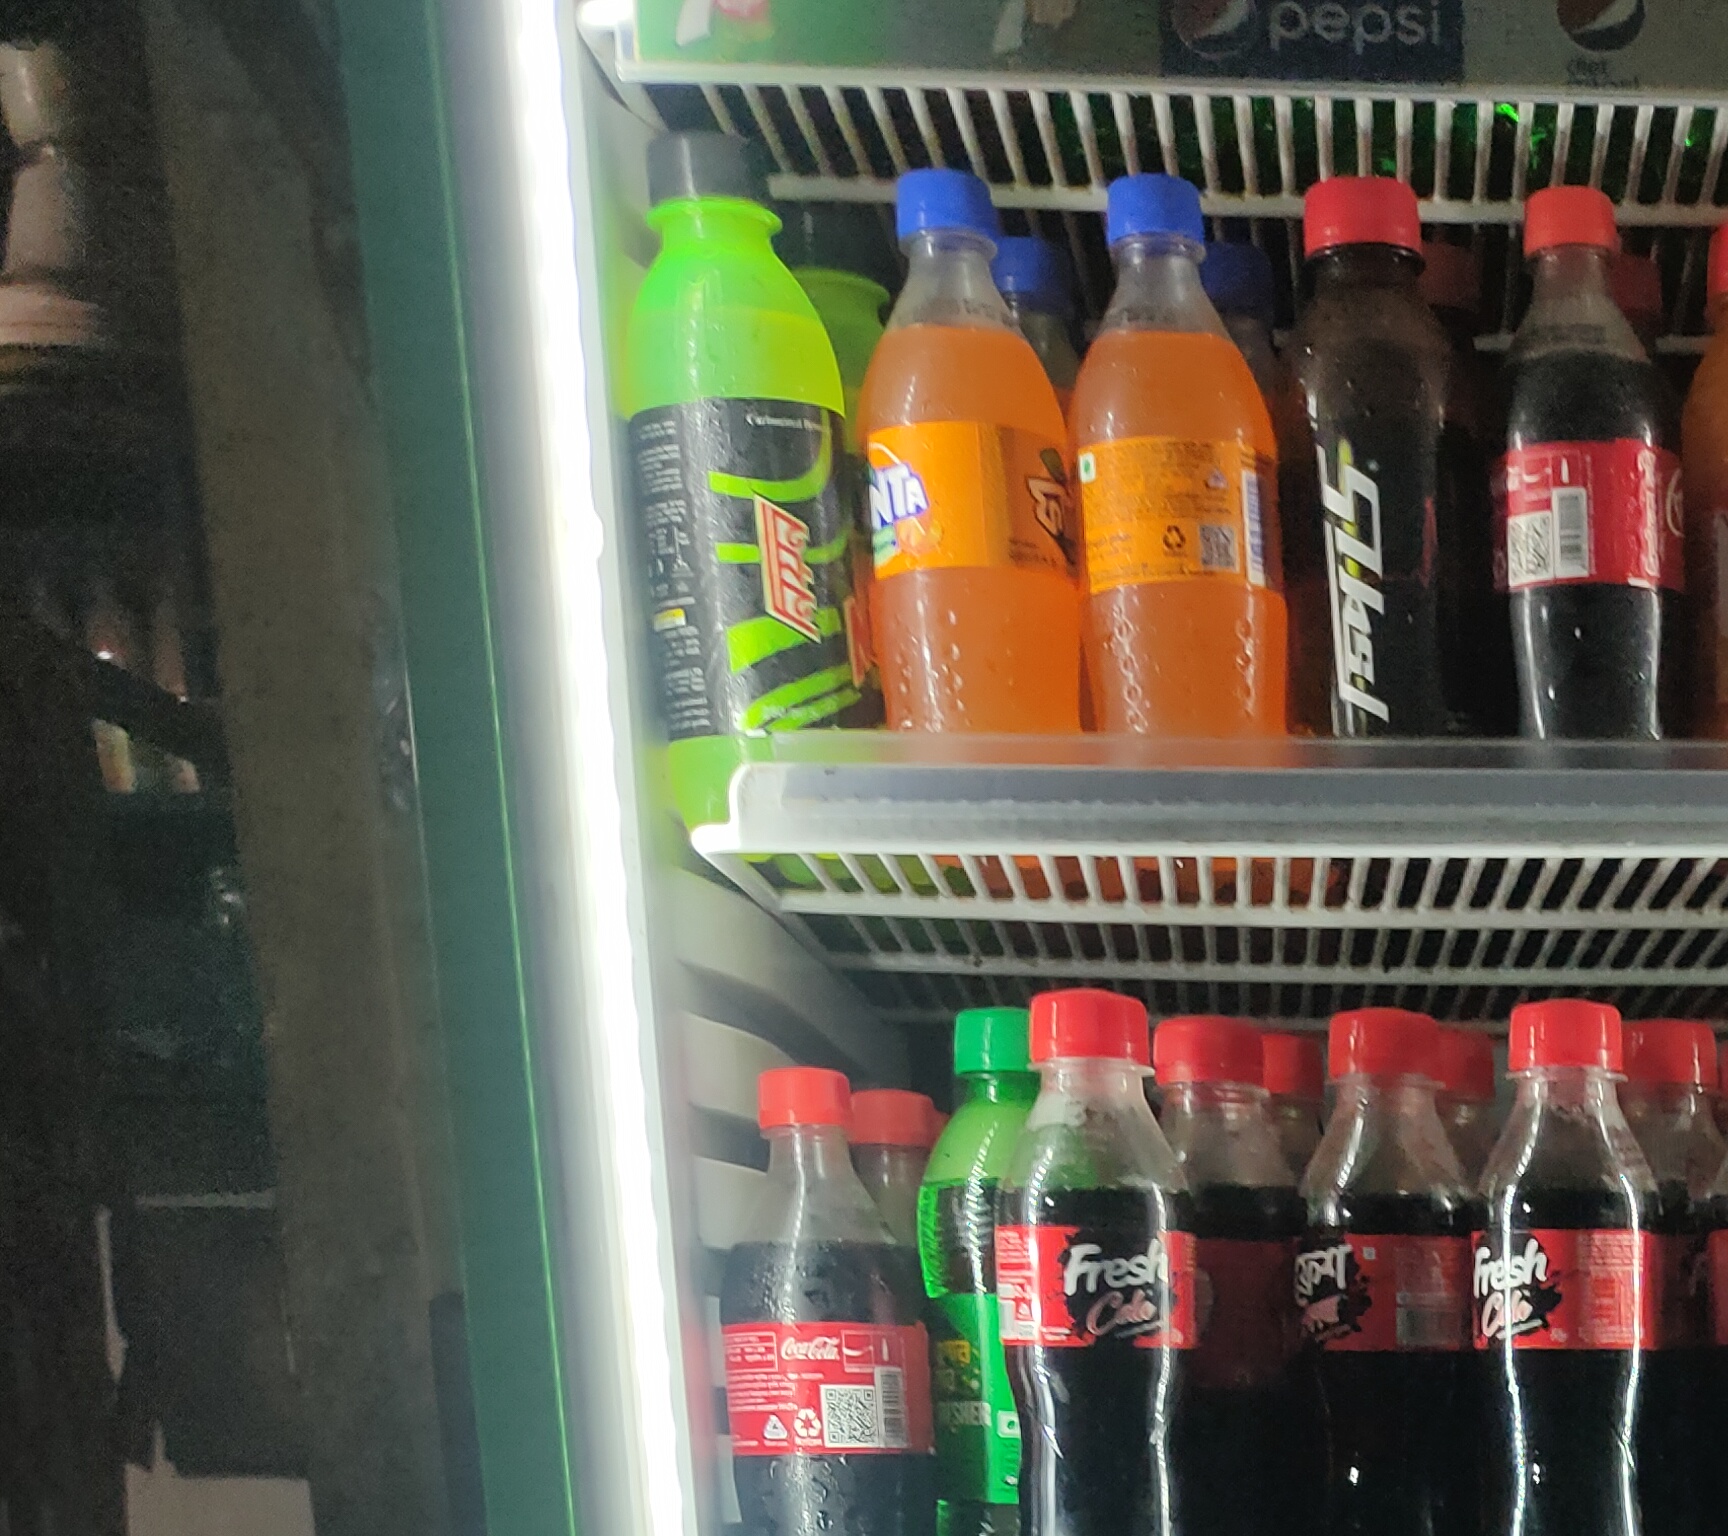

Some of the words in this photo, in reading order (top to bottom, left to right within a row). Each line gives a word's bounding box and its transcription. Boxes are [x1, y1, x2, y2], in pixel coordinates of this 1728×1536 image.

[1269, 0, 1442, 56] pepsi
[1063, 1238, 1170, 1297] Fresh
[1473, 1238, 1548, 1299] Fresh
